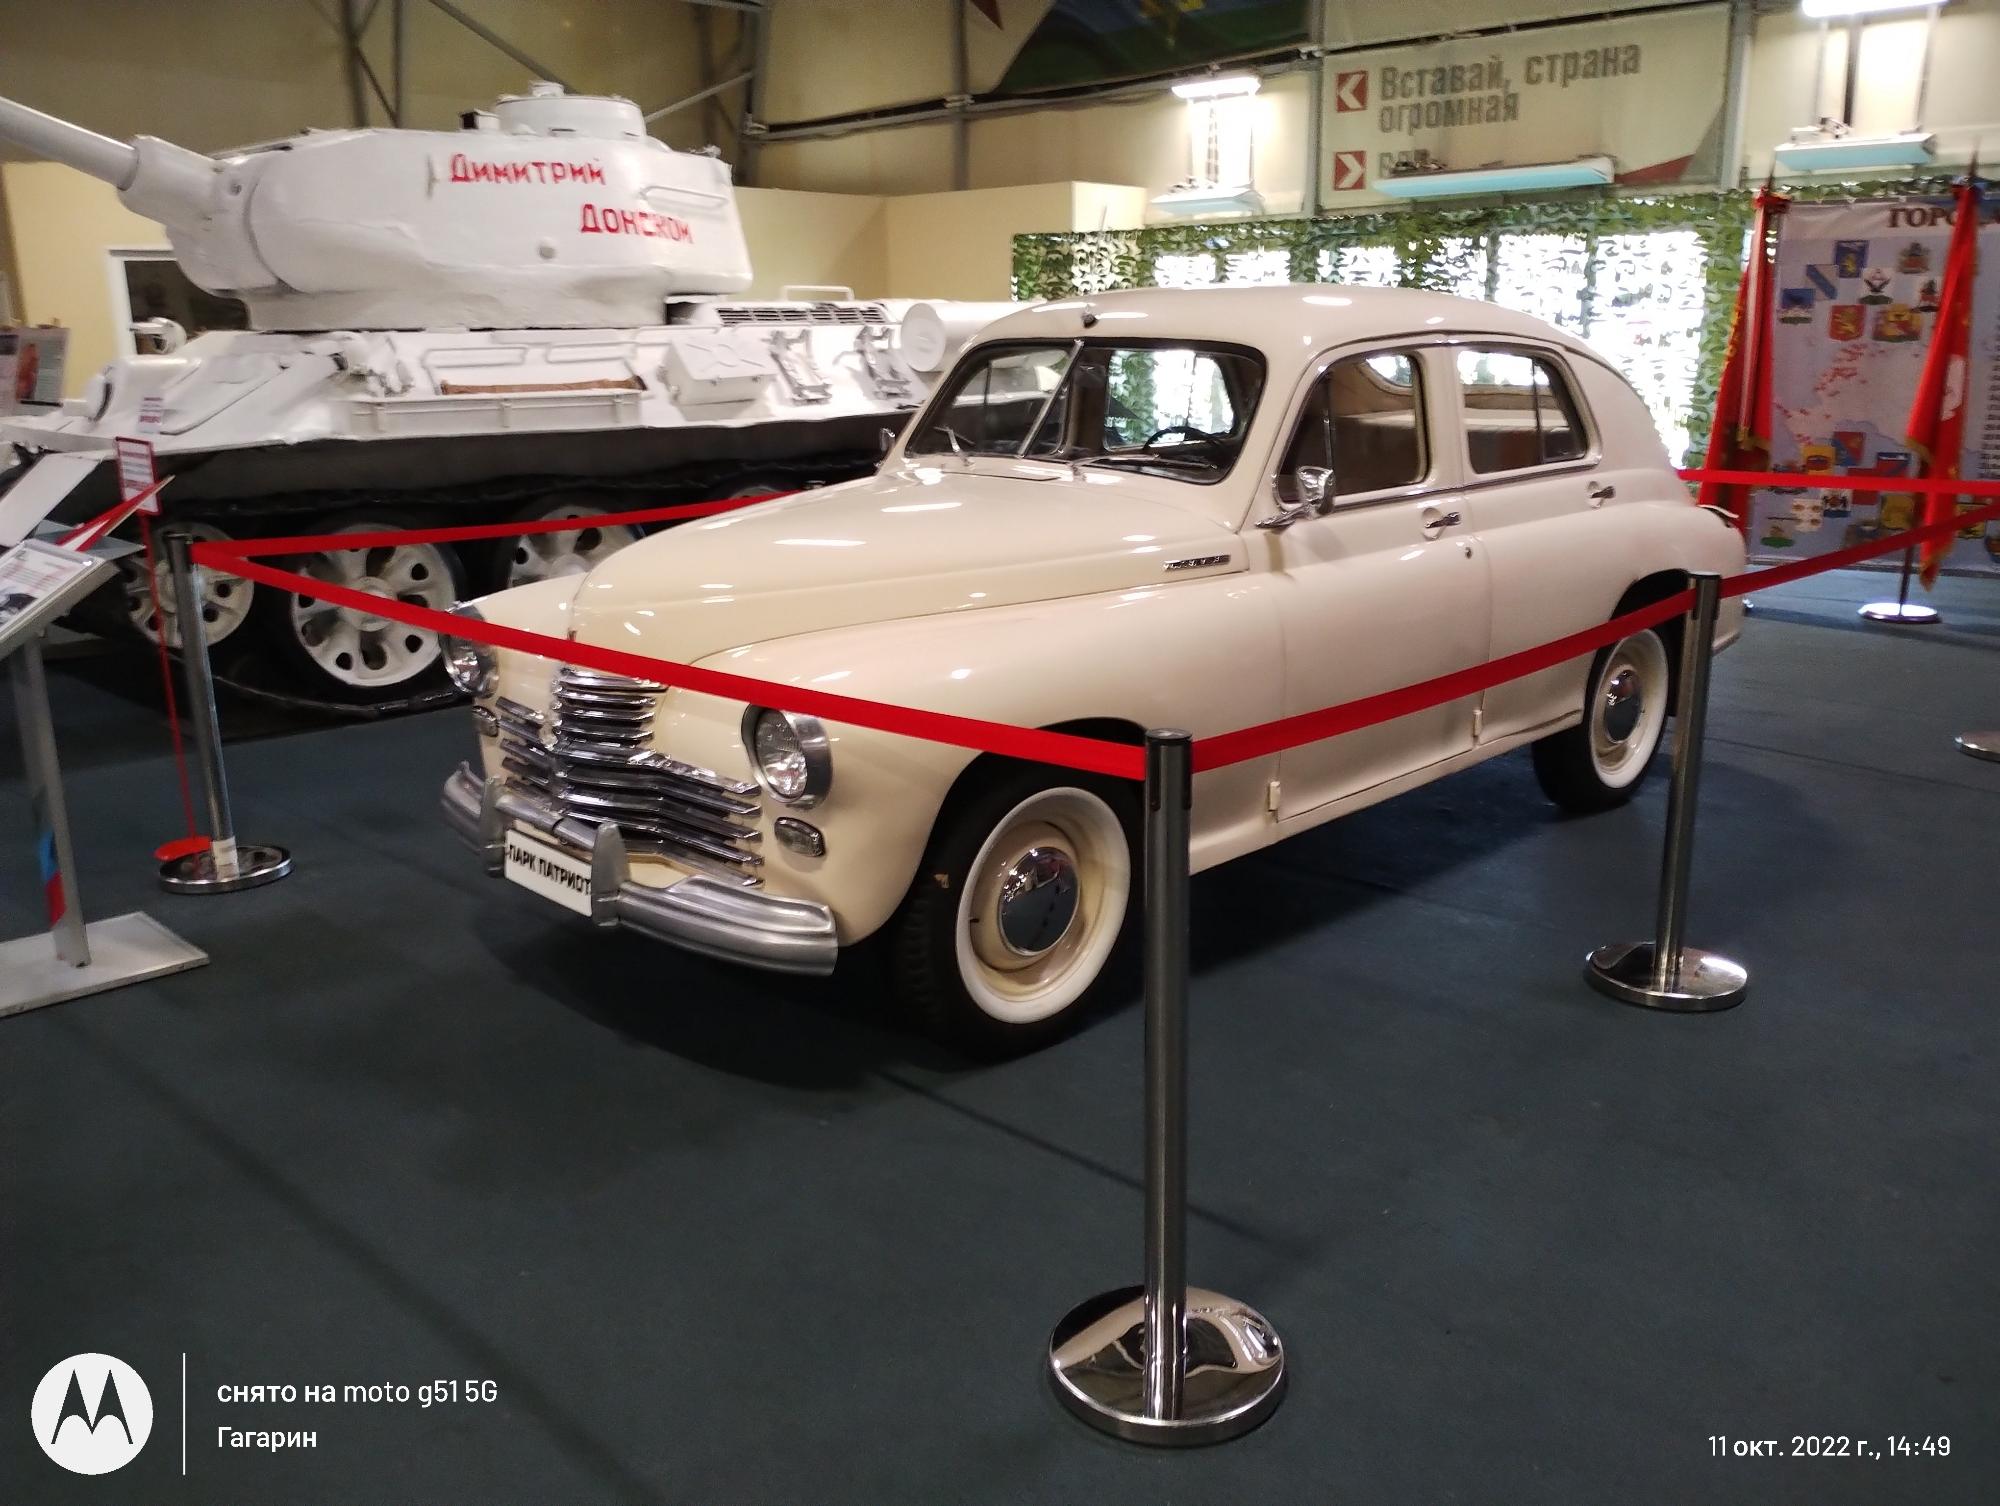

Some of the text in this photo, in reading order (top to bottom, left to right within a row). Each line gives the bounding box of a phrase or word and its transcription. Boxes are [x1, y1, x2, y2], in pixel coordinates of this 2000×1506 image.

[1380, 44, 1640, 100] Вставай, страна
[1378, 92, 1520, 135] огромная
[508, 844, 592, 896] ПАРК ПАТРИОТ
